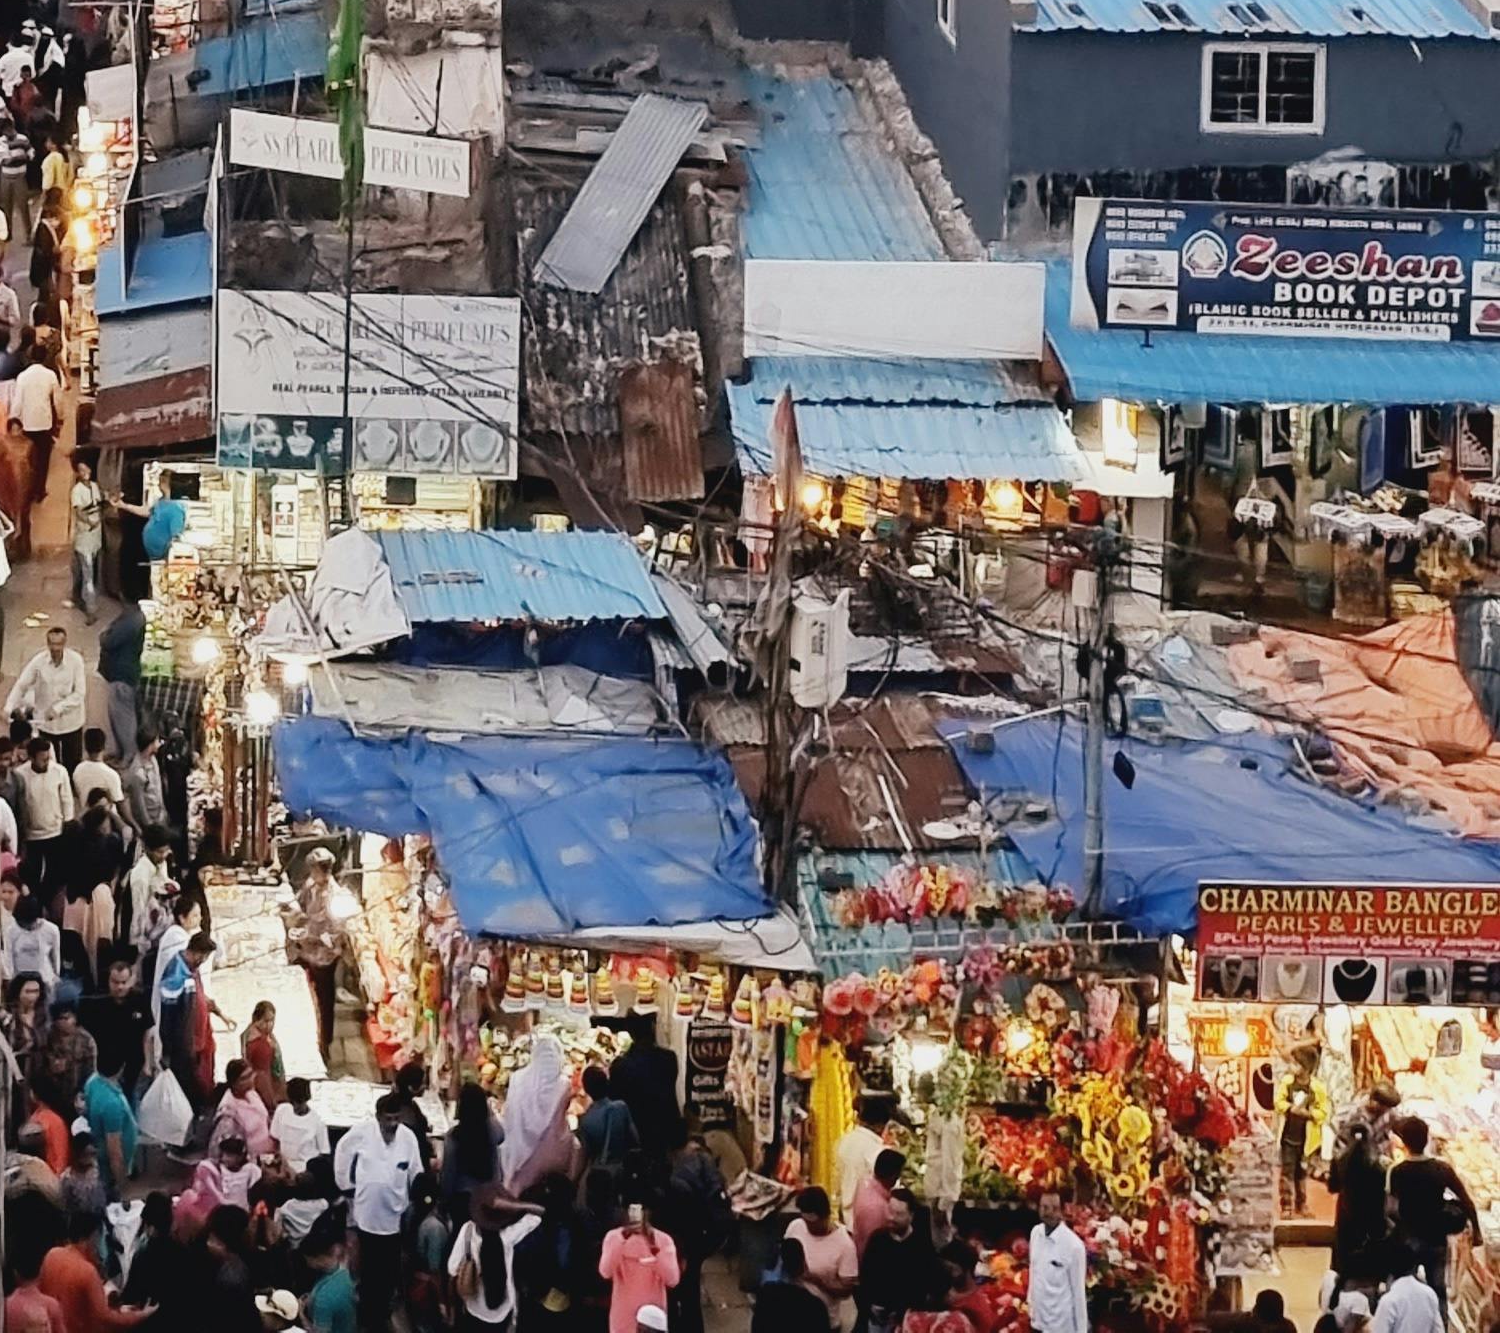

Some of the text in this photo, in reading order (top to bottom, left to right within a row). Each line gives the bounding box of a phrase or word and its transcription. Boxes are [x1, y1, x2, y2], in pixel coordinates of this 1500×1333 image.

[286, 134, 342, 165] PEARL
[370, 145, 462, 183] PERFUMES
[1230, 234, 1466, 285] Zeeshan
[1273, 282, 1467, 309] BOOK DEPOT
[1188, 302, 1460, 325] ISLAMIC BOOK SELLER & PUBLISHERS
[1200, 888, 1500, 916] CHARMINAR BANGLE
[1235, 915, 1483, 936] PEARLS & JEWELLERY
